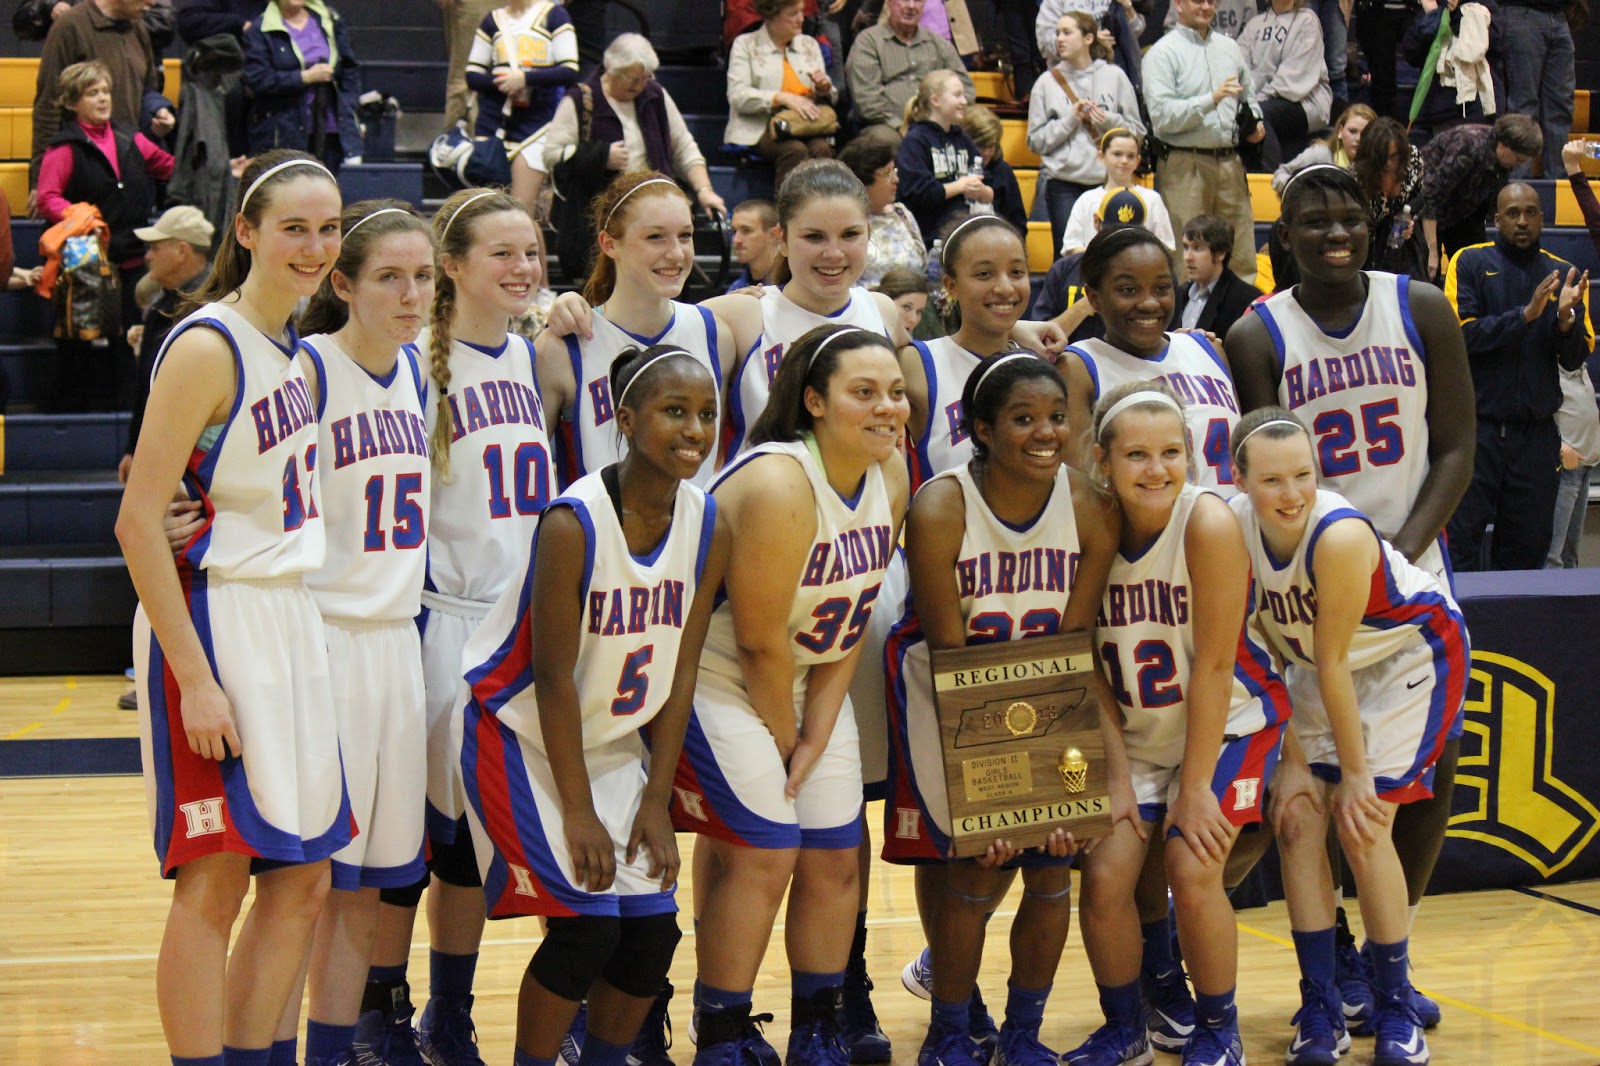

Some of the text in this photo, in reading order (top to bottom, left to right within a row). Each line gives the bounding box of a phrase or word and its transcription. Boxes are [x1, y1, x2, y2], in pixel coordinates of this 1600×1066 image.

[1151, 372, 1237, 415] DING
[1285, 346, 1416, 411] HARDING
[1313, 398, 1405, 477] 25
[483, 441, 550, 519] 10
[364, 472, 426, 553] 15
[794, 581, 882, 654] 35
[610, 644, 654, 717] 5
[954, 658, 1077, 687] REGIONAL
[1100, 640, 1184, 709] 12
[971, 757, 1006, 769] DIVISION
[972, 773, 1023, 786] BASKETBALL
[985, 767, 1008, 777] GIRLS
[179, 796, 226, 838] H
[962, 798, 1103, 832] CHAMPIONS
